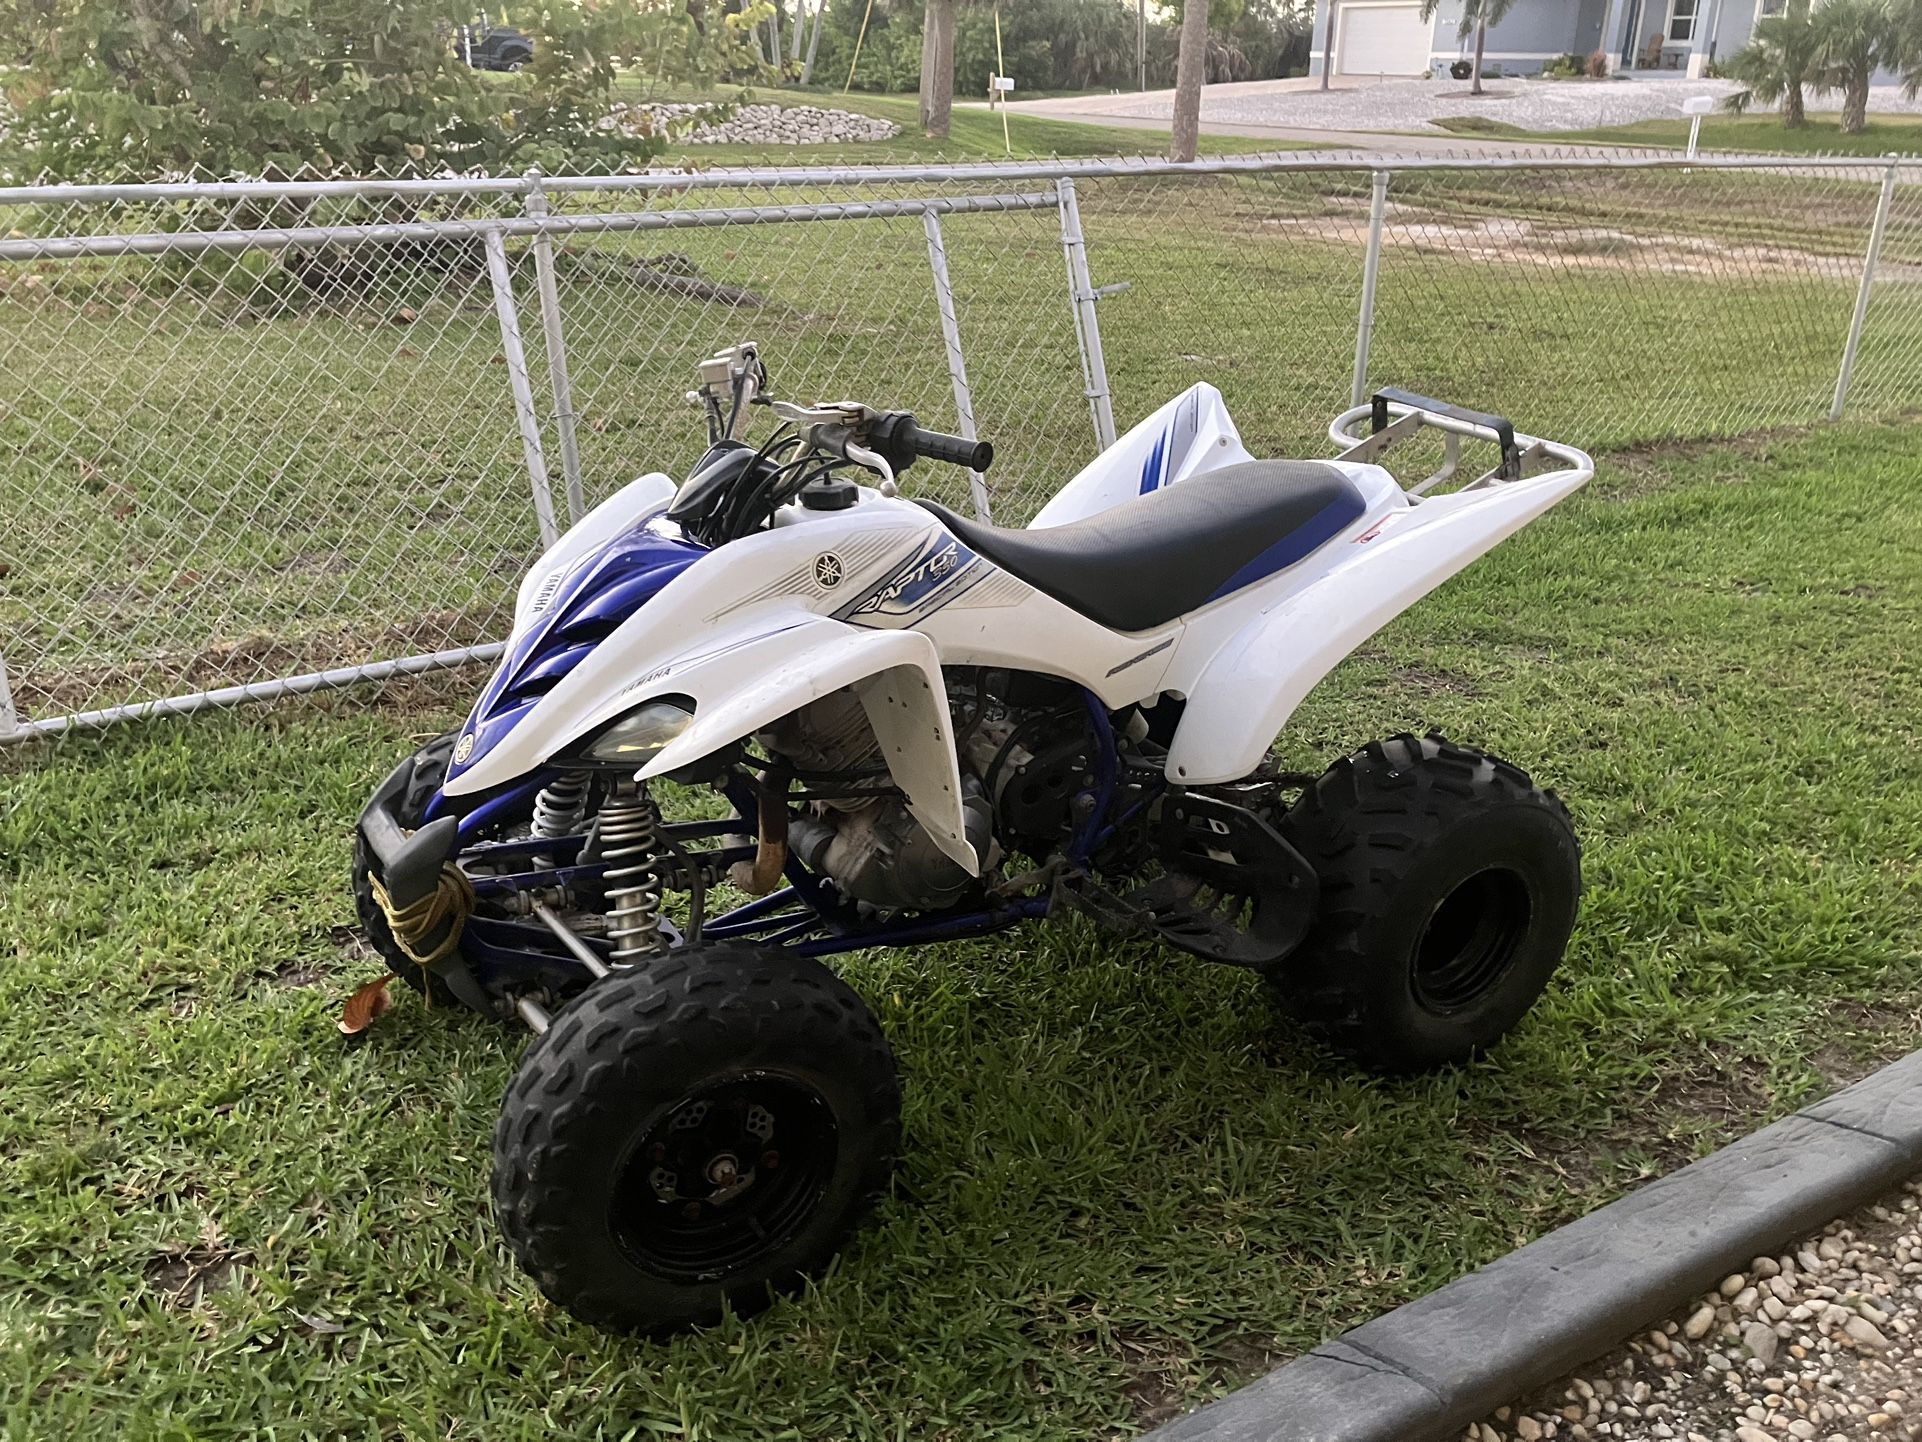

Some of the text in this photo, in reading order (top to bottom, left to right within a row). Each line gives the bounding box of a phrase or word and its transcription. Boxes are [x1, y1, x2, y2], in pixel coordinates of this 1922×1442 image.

[532, 572, 564, 613] YAMAHA
[853, 541, 958, 613] RAPTOR
[620, 667, 671, 697] YAMAHA
